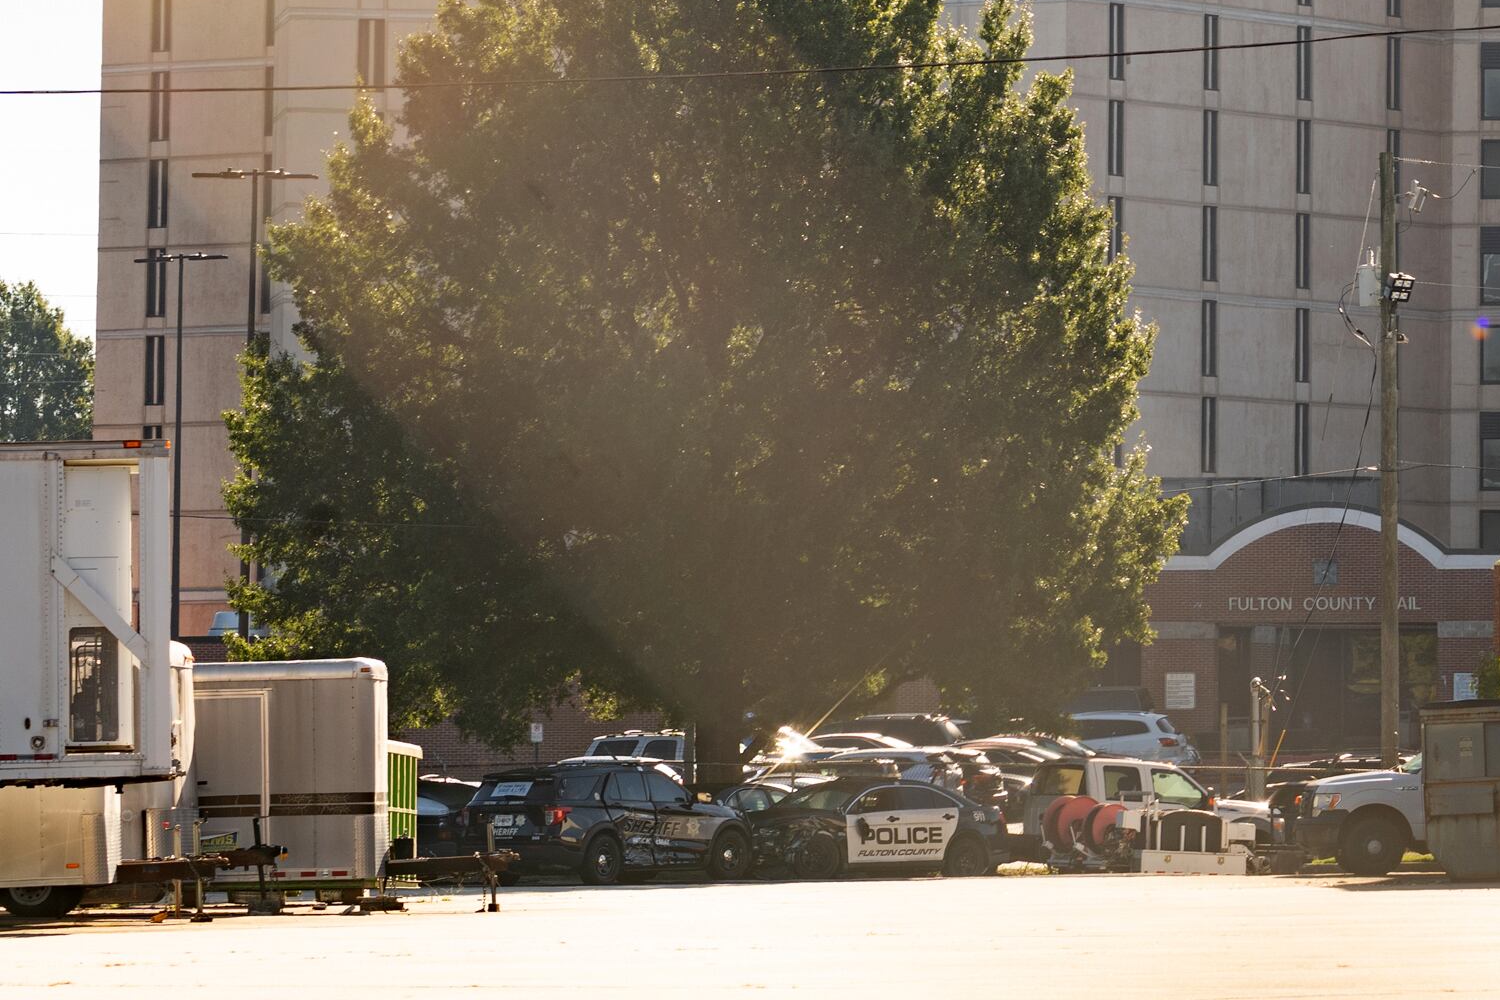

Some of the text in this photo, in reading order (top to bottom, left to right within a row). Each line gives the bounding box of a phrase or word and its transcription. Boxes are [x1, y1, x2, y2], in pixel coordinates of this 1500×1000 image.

[1228, 596, 1422, 611] FULTON COUNTY AIL
[493, 827, 519, 836] HERIFF
[860, 827, 943, 845] POLICE
[858, 848, 942, 857] FULTON COUNTY
